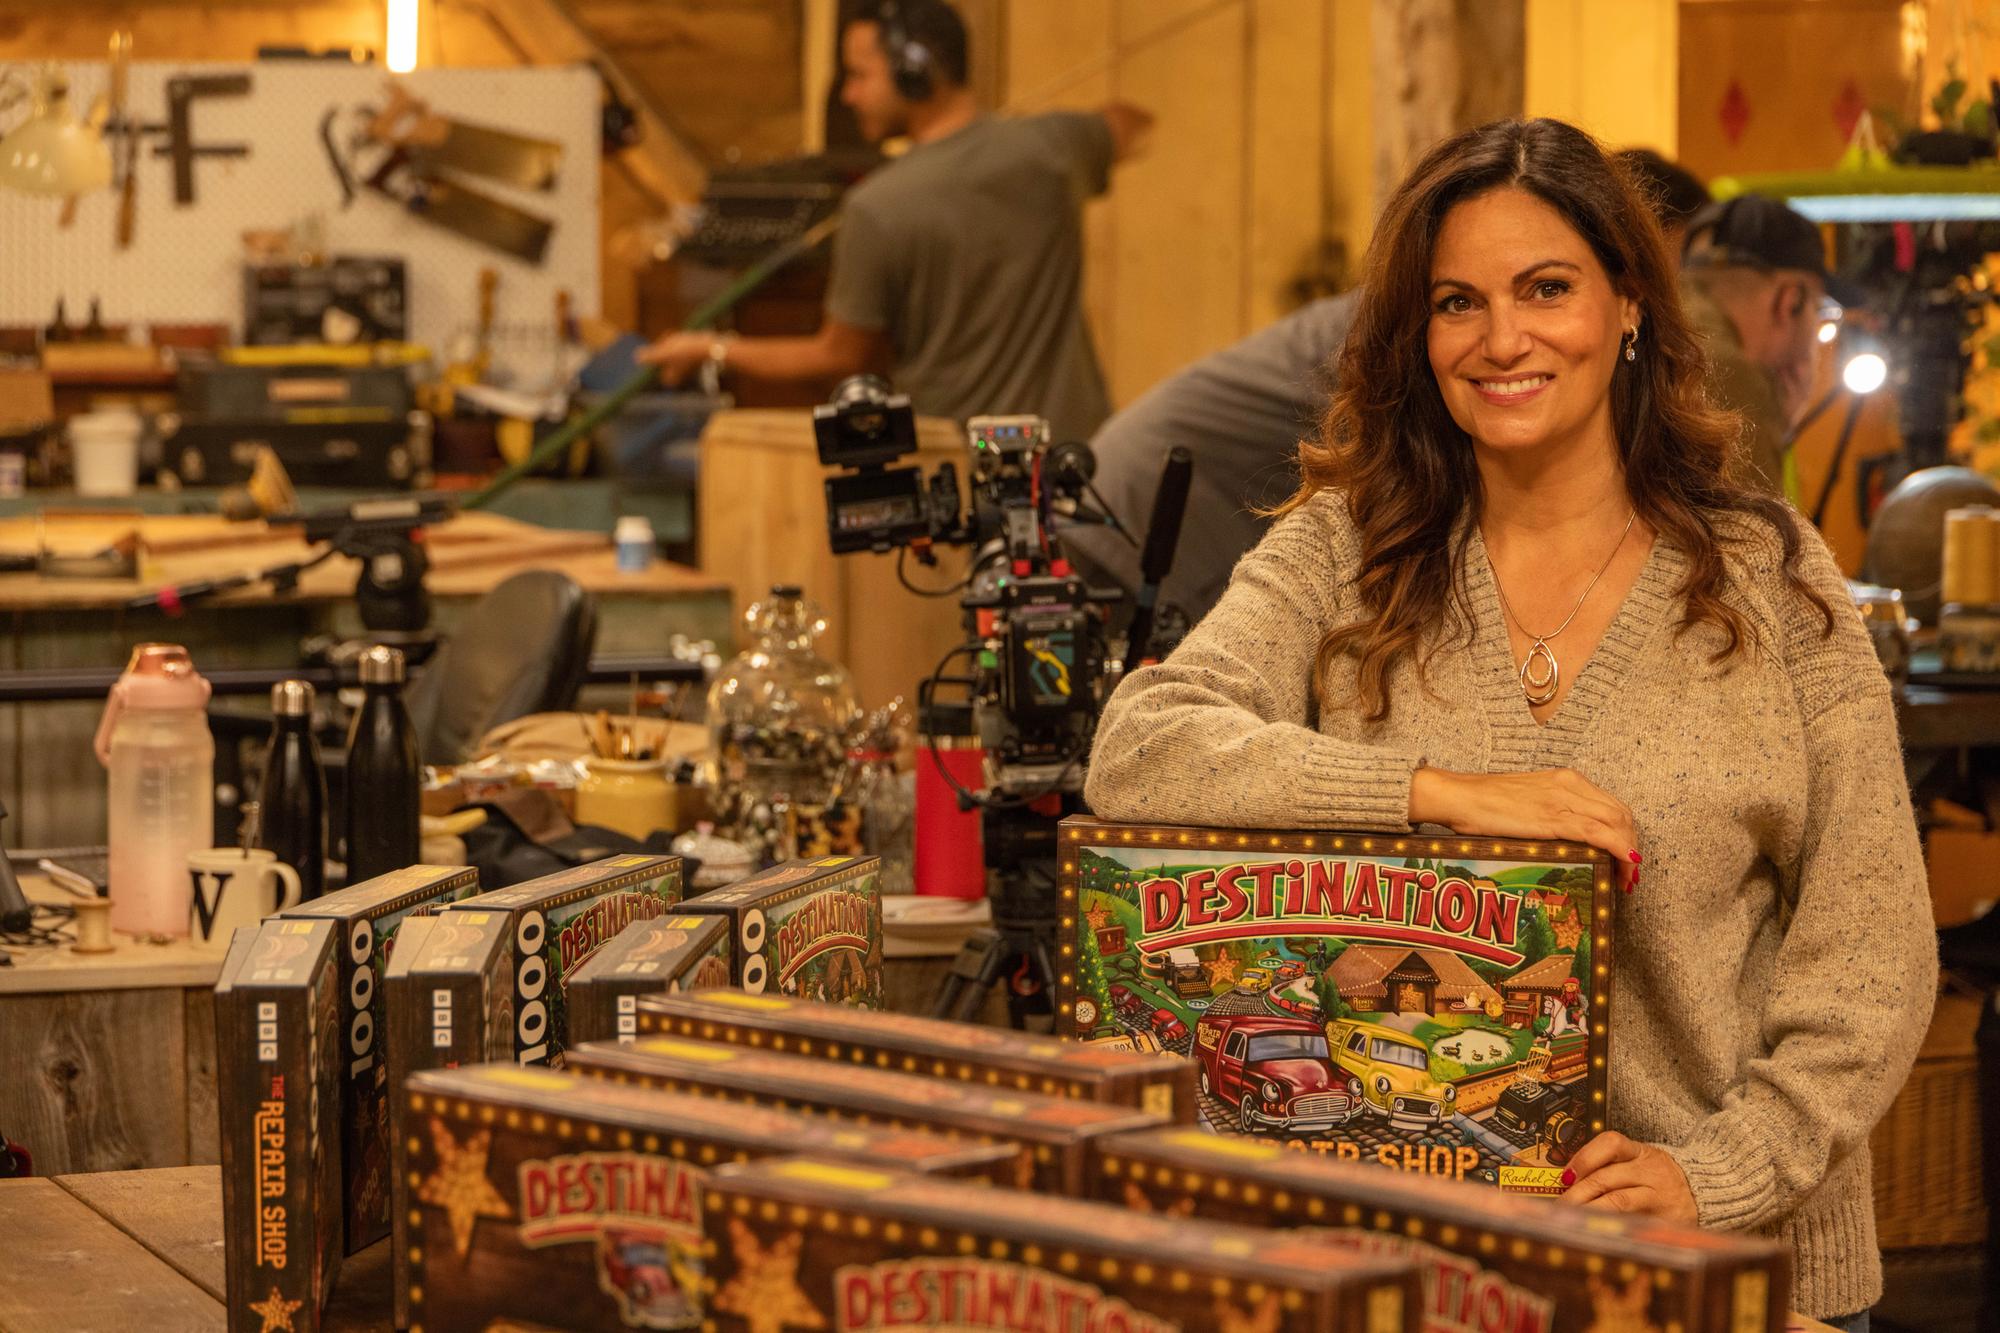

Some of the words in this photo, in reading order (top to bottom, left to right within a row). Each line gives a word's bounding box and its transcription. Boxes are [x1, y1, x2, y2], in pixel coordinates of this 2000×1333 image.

[351, 919, 373, 1080] 1000
[260, 1005, 275, 1058] BBC
[1198, 1022, 1221, 1039] REPAIR
[272, 1075, 284, 1099] THE
[261, 1101, 285, 1198] REPAIR
[1377, 1143, 1479, 1182] SHOP
[1501, 1168, 1546, 1185] Rachel
[264, 1206, 287, 1270] SHOP
